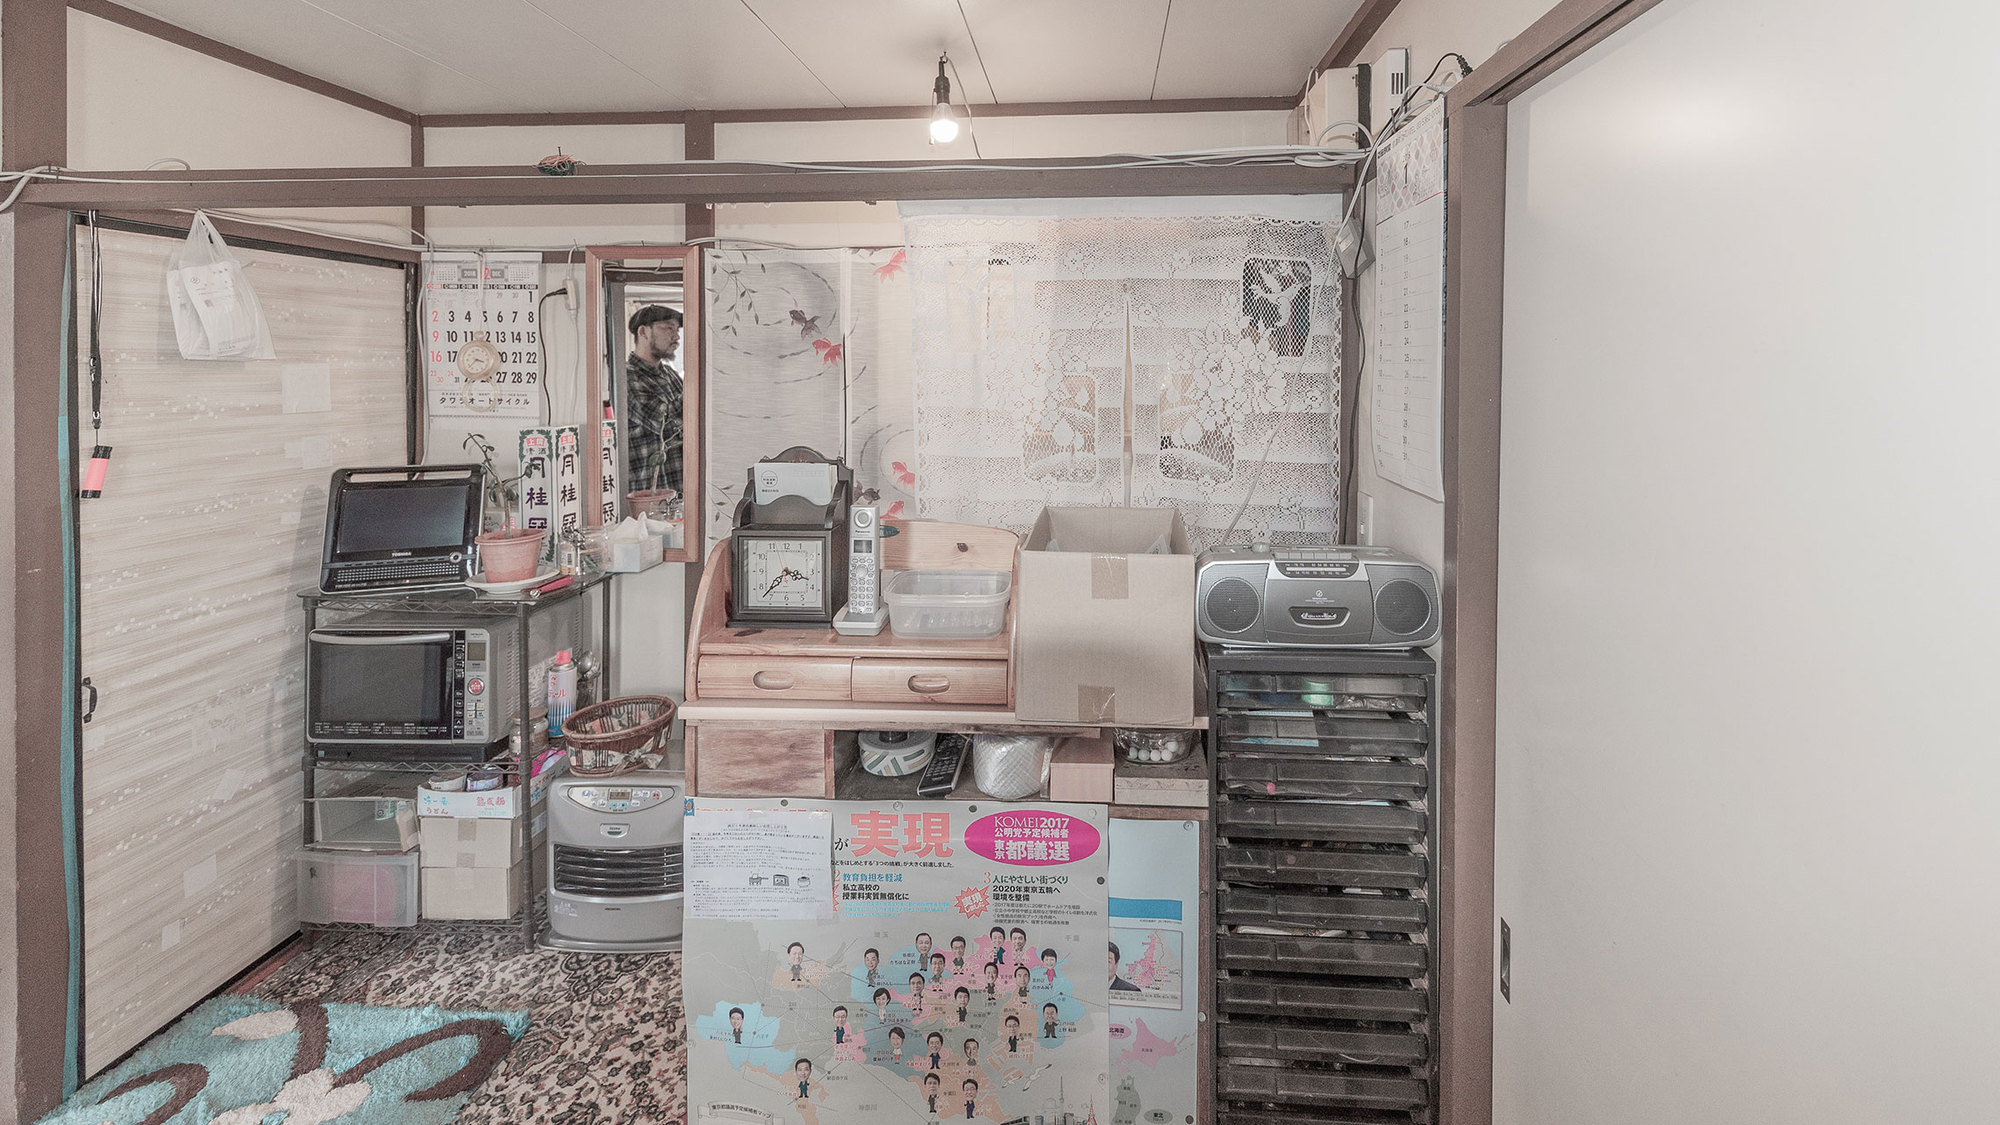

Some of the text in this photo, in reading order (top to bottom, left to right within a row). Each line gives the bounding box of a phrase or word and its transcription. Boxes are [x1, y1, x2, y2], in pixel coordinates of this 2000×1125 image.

[528, 291, 533, 303] 1
[431, 310, 535, 323] 2 3 4 5 6 7 8
[432, 330, 440, 342] 9
[446, 331, 458, 343] 10
[463, 331, 474, 343] 11
[495, 332, 507, 343] 13
[510, 332, 522, 343] 14
[526, 332, 536, 344] 15
[430, 351, 442, 363] 16
[447, 351, 458, 363] 17
[511, 352, 522, 364] 21
[525, 352, 537, 364] 22
[495, 371, 508, 383] 27
[511, 372, 523, 384] 28
[525, 372, 537, 384] 29
[834, 810, 955, 859] が 実現
[994, 828, 1070, 839] 公明党予定候補者
[842, 872, 903, 883] 教育負担を軽減
[992, 875, 1069, 885] 人にやさしい街づくり
[992, 885, 1061, 894] 2020年東京五輪へ
[992, 893, 1030, 901] 環境を整備
